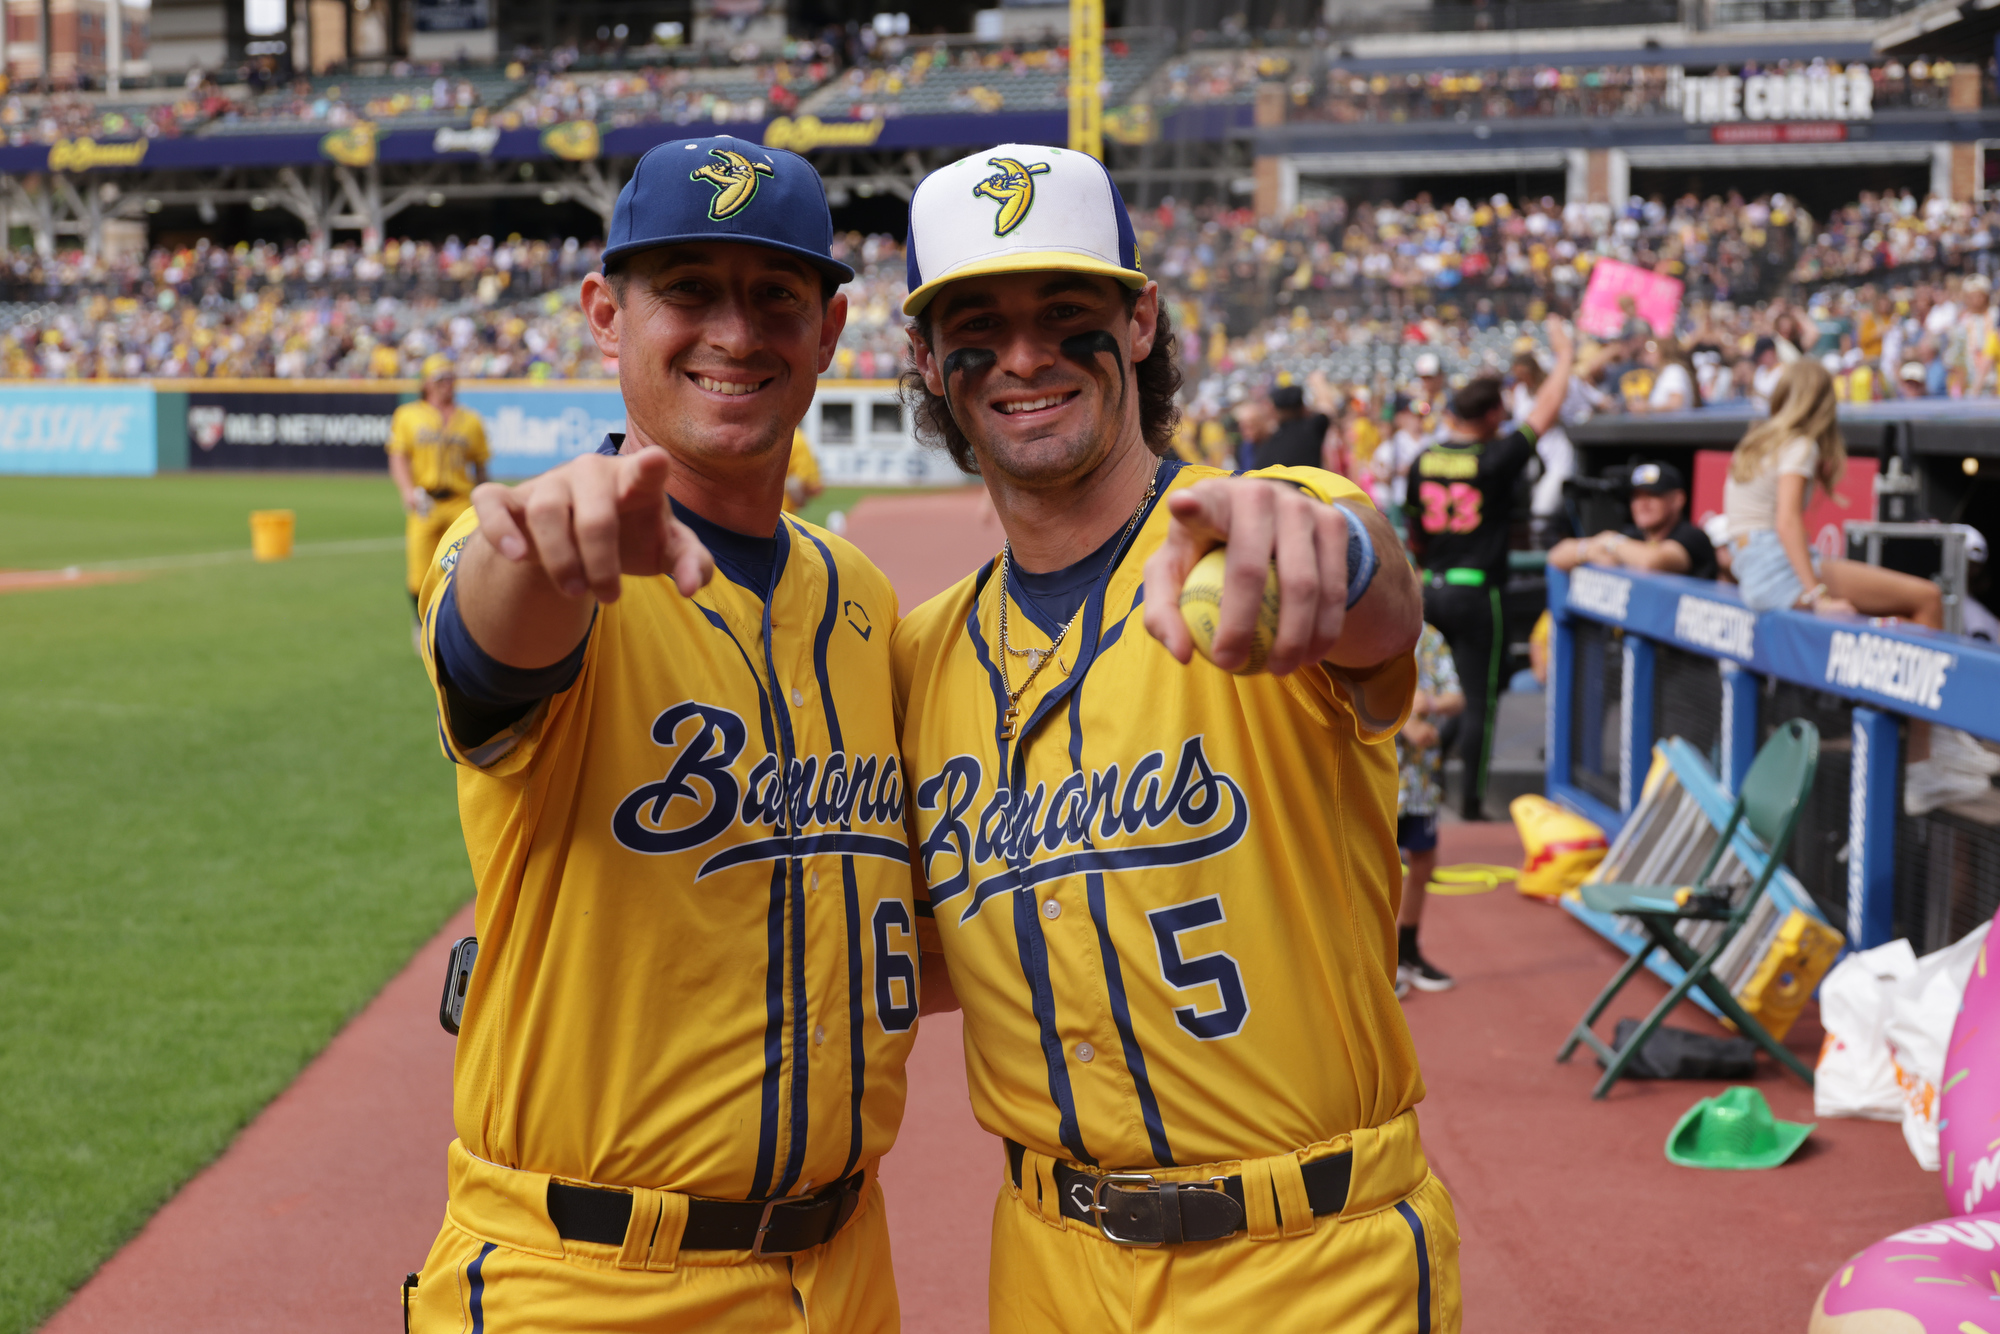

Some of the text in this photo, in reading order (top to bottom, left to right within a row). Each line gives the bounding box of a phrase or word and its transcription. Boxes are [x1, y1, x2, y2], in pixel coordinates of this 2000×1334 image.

[1684, 74, 1874, 122] THE CORNER
[224, 413, 278, 445] MLB
[279, 413, 391, 446] NETWORK
[1418, 482, 1483, 534] 33
[1825, 630, 1950, 711] PROGRESSIVE
[1000, 708, 1020, 740] 5
[610, 698, 907, 855] Banana
[916, 732, 1250, 910] Bananas
[871, 898, 922, 1035] 6
[1144, 892, 1252, 1042] 5
